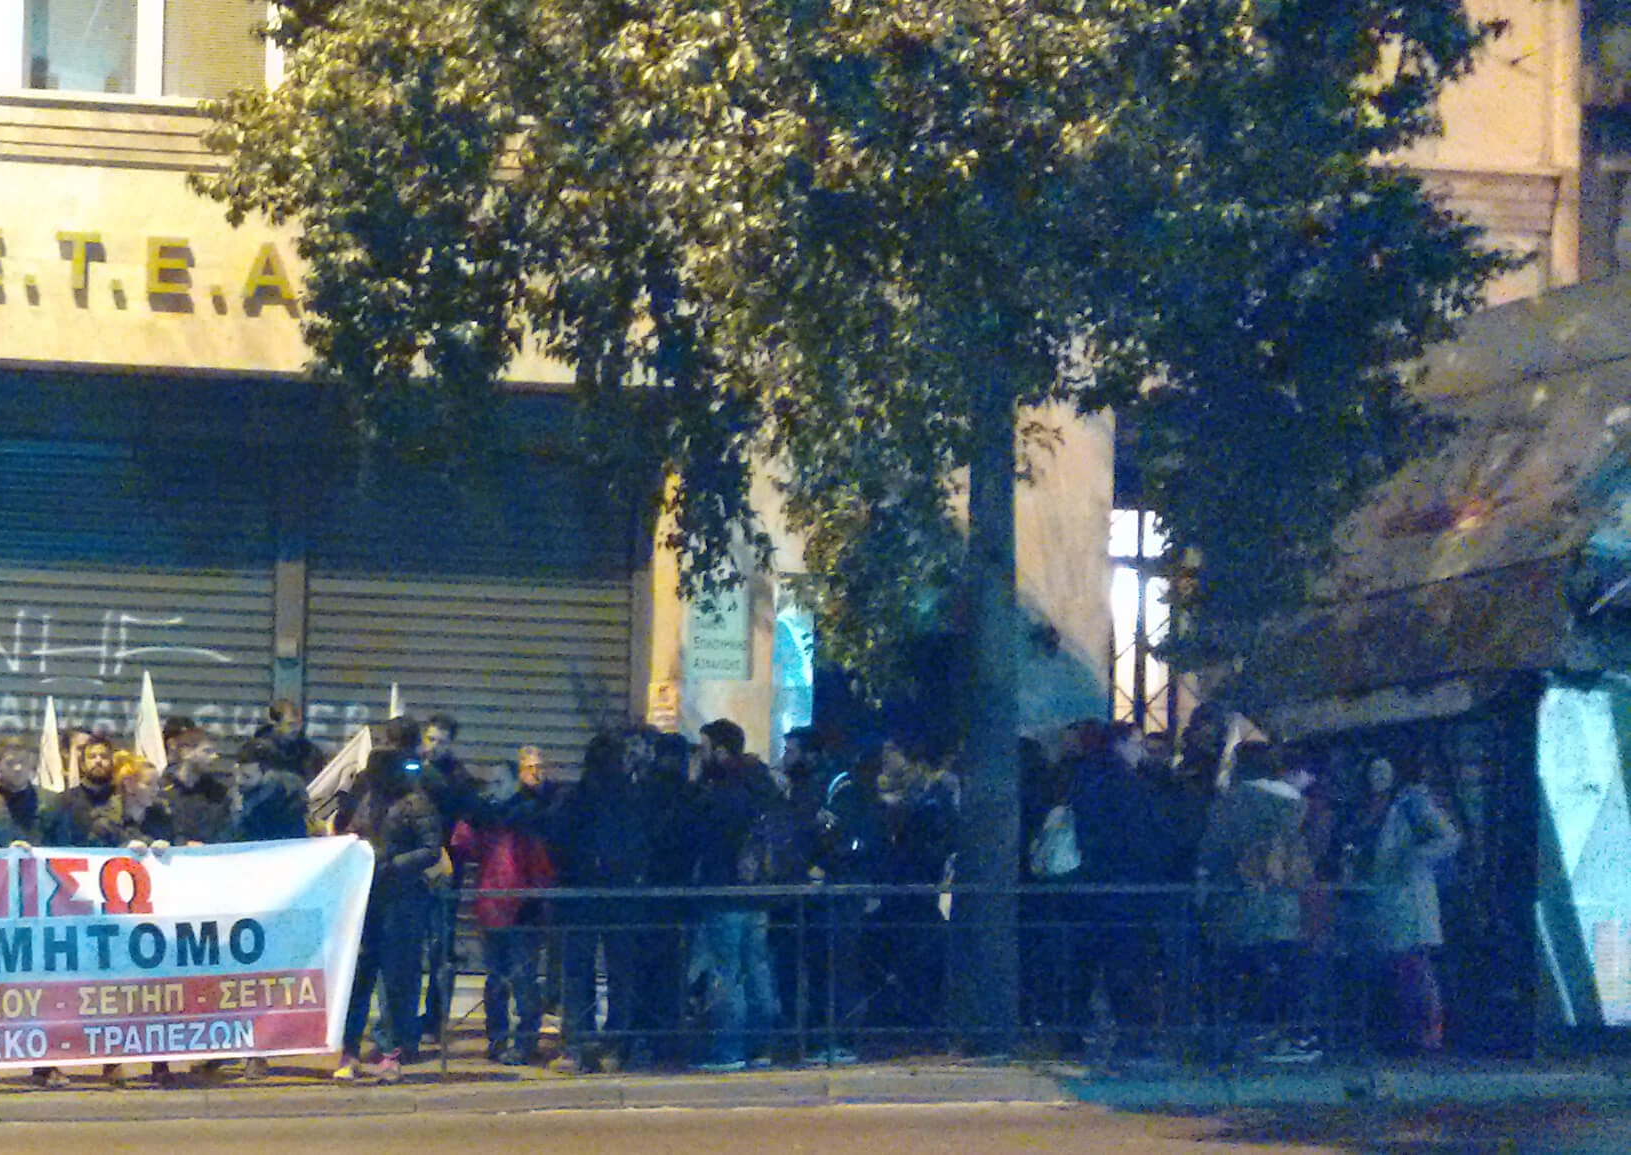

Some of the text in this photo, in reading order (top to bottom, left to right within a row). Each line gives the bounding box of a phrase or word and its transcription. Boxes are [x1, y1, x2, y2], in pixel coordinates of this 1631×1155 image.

[78, 983, 185, 1016] ΣΕΤΗΠ
[219, 976, 318, 1010] ΣΕΤΤΑ
[83, 1018, 255, 1057] ΤΡΑΠΕΖΩΝ
